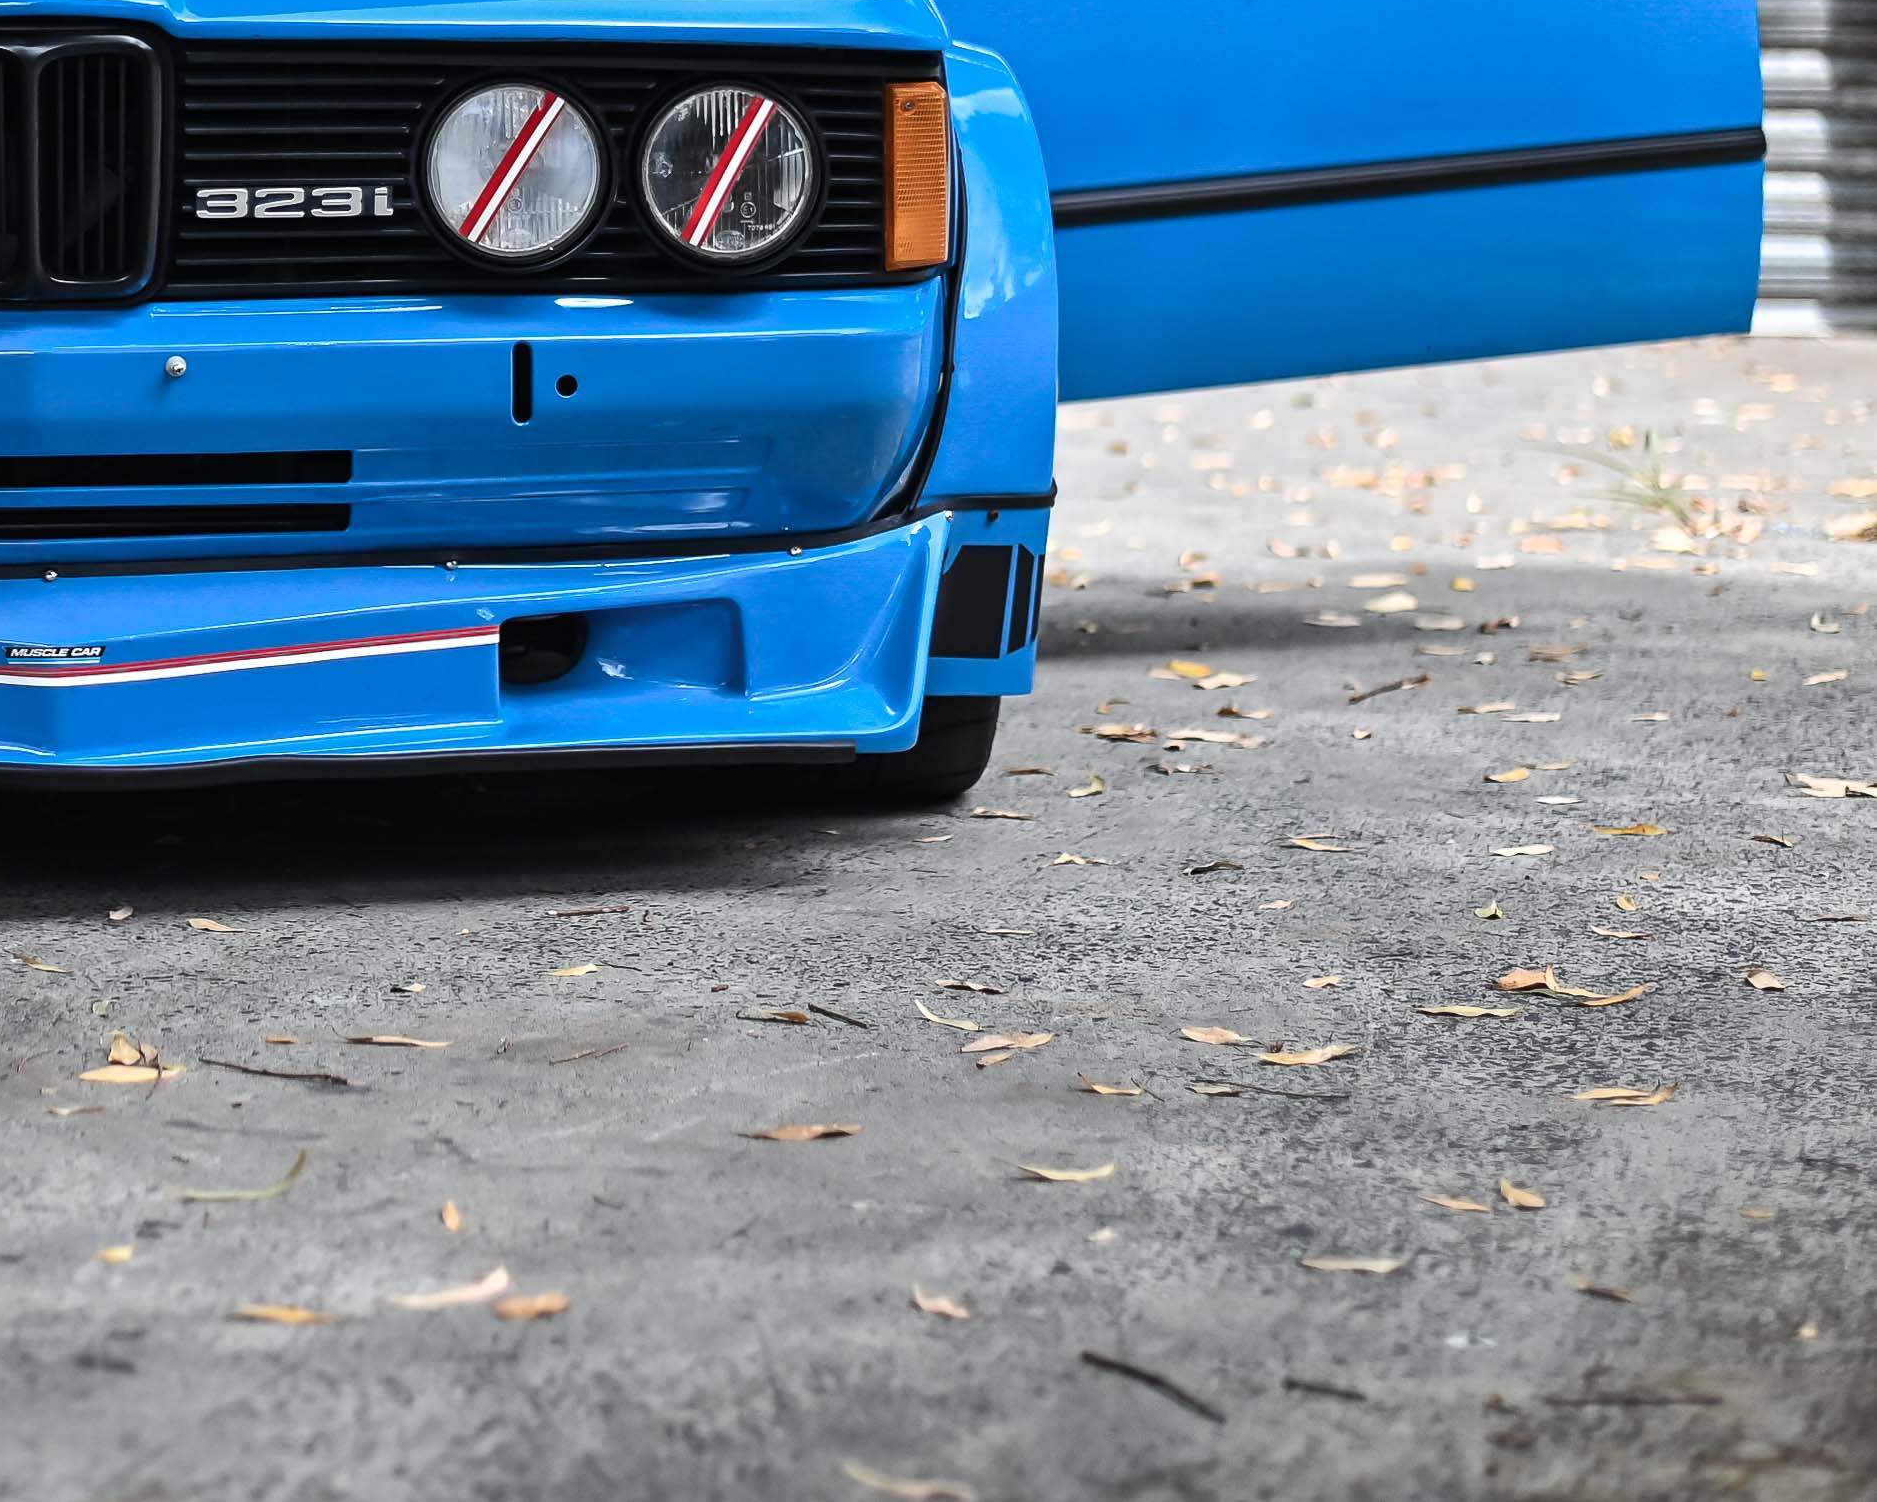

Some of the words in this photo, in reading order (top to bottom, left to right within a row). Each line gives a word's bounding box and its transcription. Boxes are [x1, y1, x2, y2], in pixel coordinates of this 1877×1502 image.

[196, 187, 394, 219] 323i
[10, 647, 69, 658] MUSCLE
[70, 646, 102, 657] CAR
